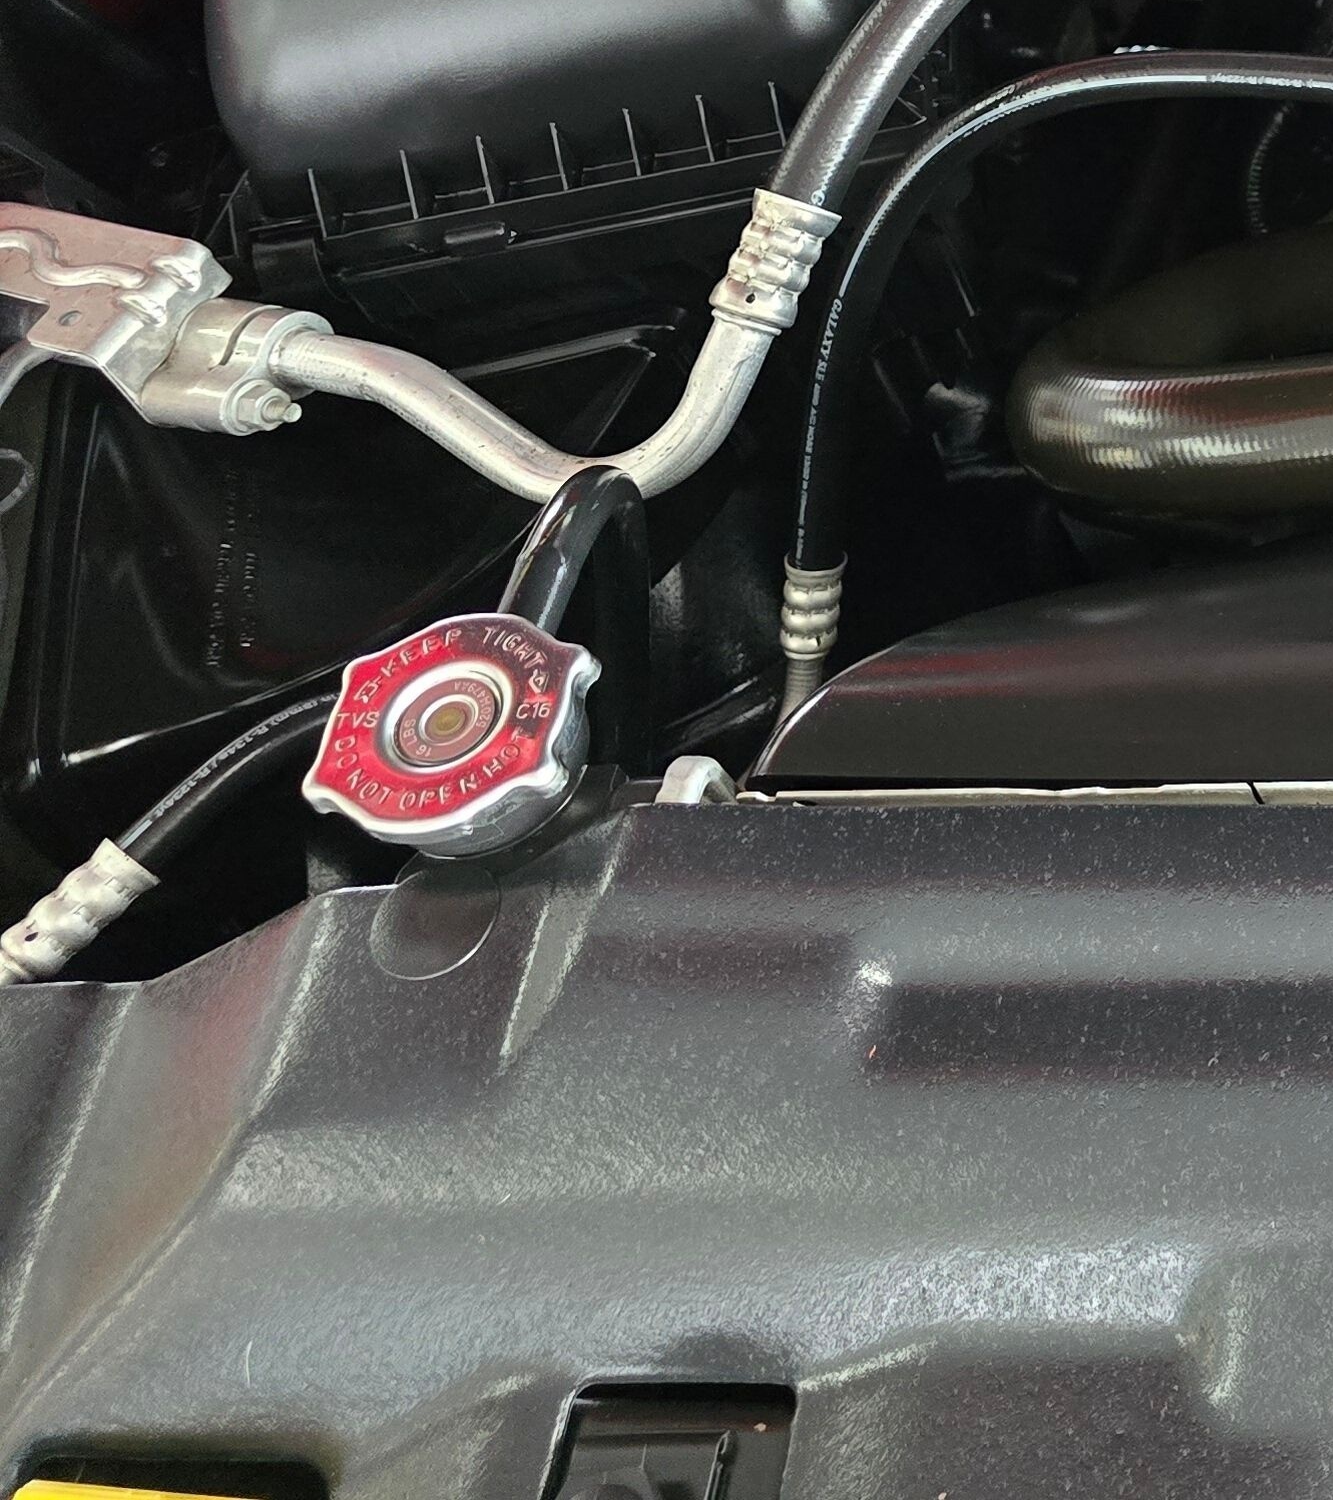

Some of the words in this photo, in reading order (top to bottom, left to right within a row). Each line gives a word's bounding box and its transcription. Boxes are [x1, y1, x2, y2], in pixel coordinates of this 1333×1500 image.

[820, 298, 842, 360] GALAXY
[381, 627, 464, 678] KEEP
[483, 626, 547, 671] TIGHT
[336, 710, 380, 728] TVS
[516, 700, 552, 721] C16
[402, 718, 418, 746] LBS
[334, 736, 358, 769] DO
[347, 768, 394, 804] NOT
[399, 772, 482, 810] OPEN
[481, 726, 533, 780] HOT
[415, 744, 432, 757] 16
